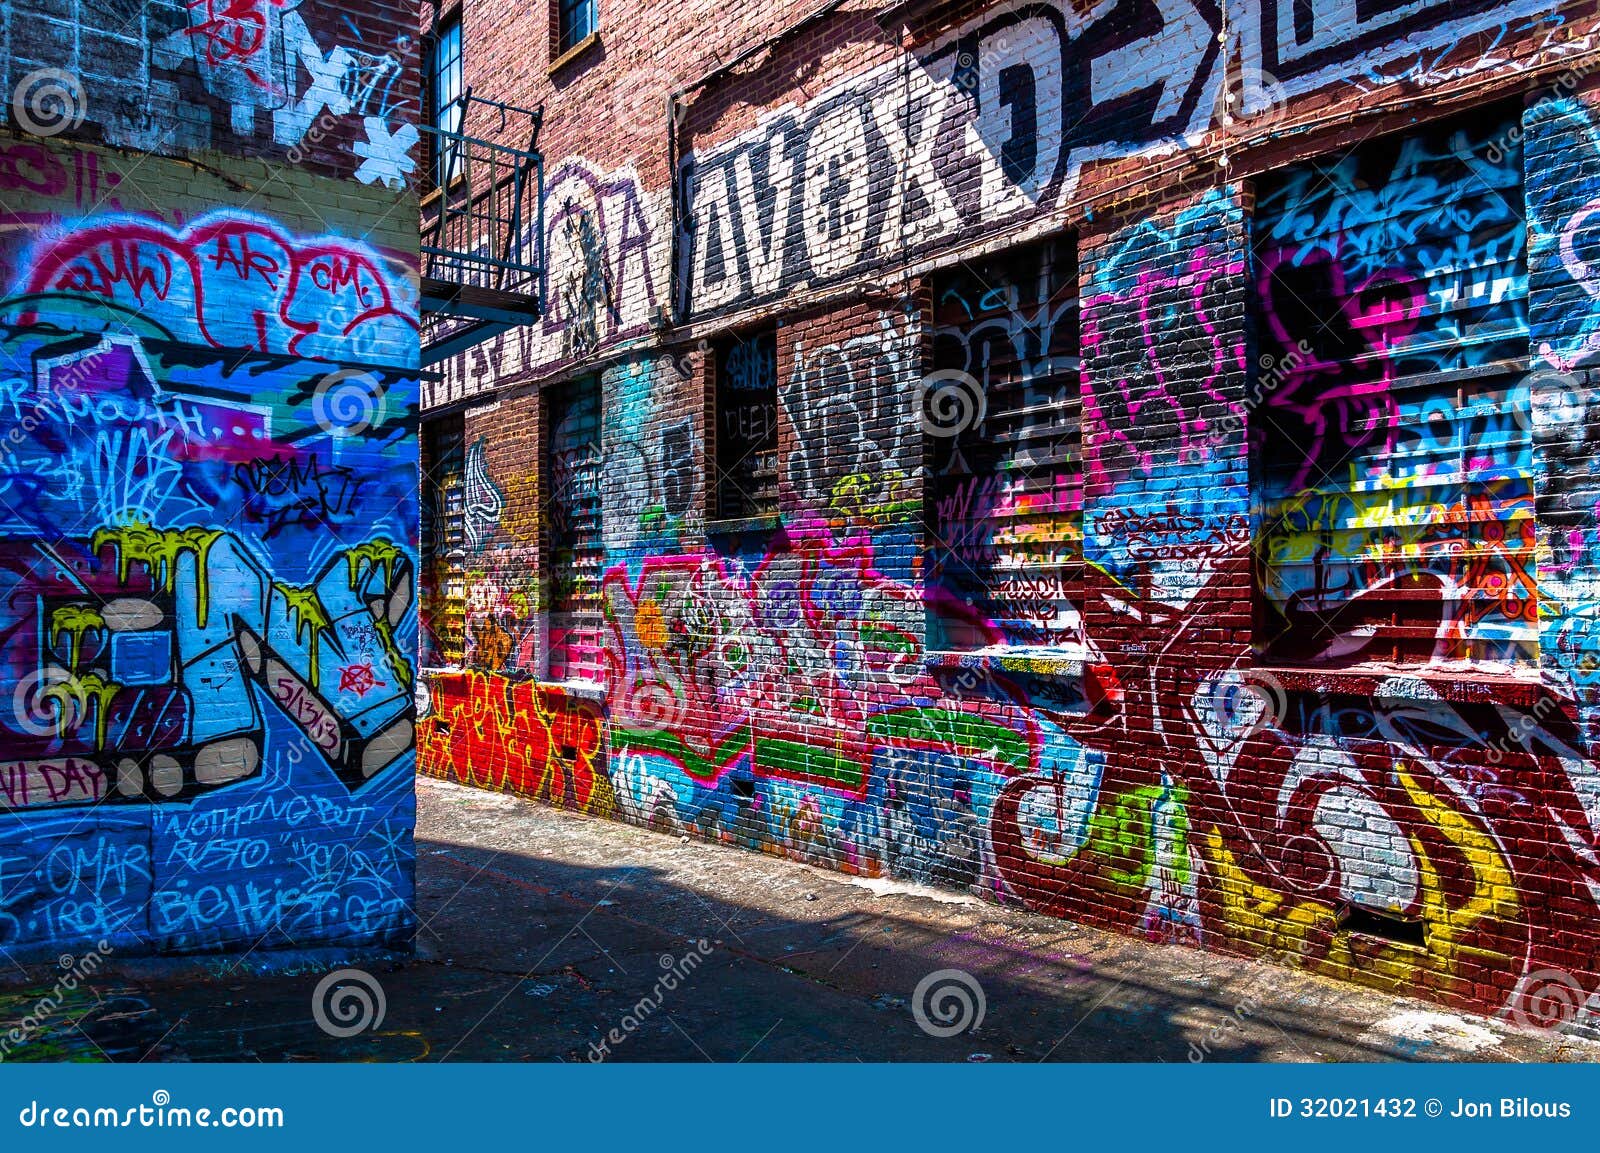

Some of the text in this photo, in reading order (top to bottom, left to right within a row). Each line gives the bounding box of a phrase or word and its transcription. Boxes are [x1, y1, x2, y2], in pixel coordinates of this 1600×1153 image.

[726, 403, 777, 441] DEEP
[274, 677, 338, 749] 5/13/13
[38, 758, 104, 802] DAY
[47, 836, 153, 906] OMAR
